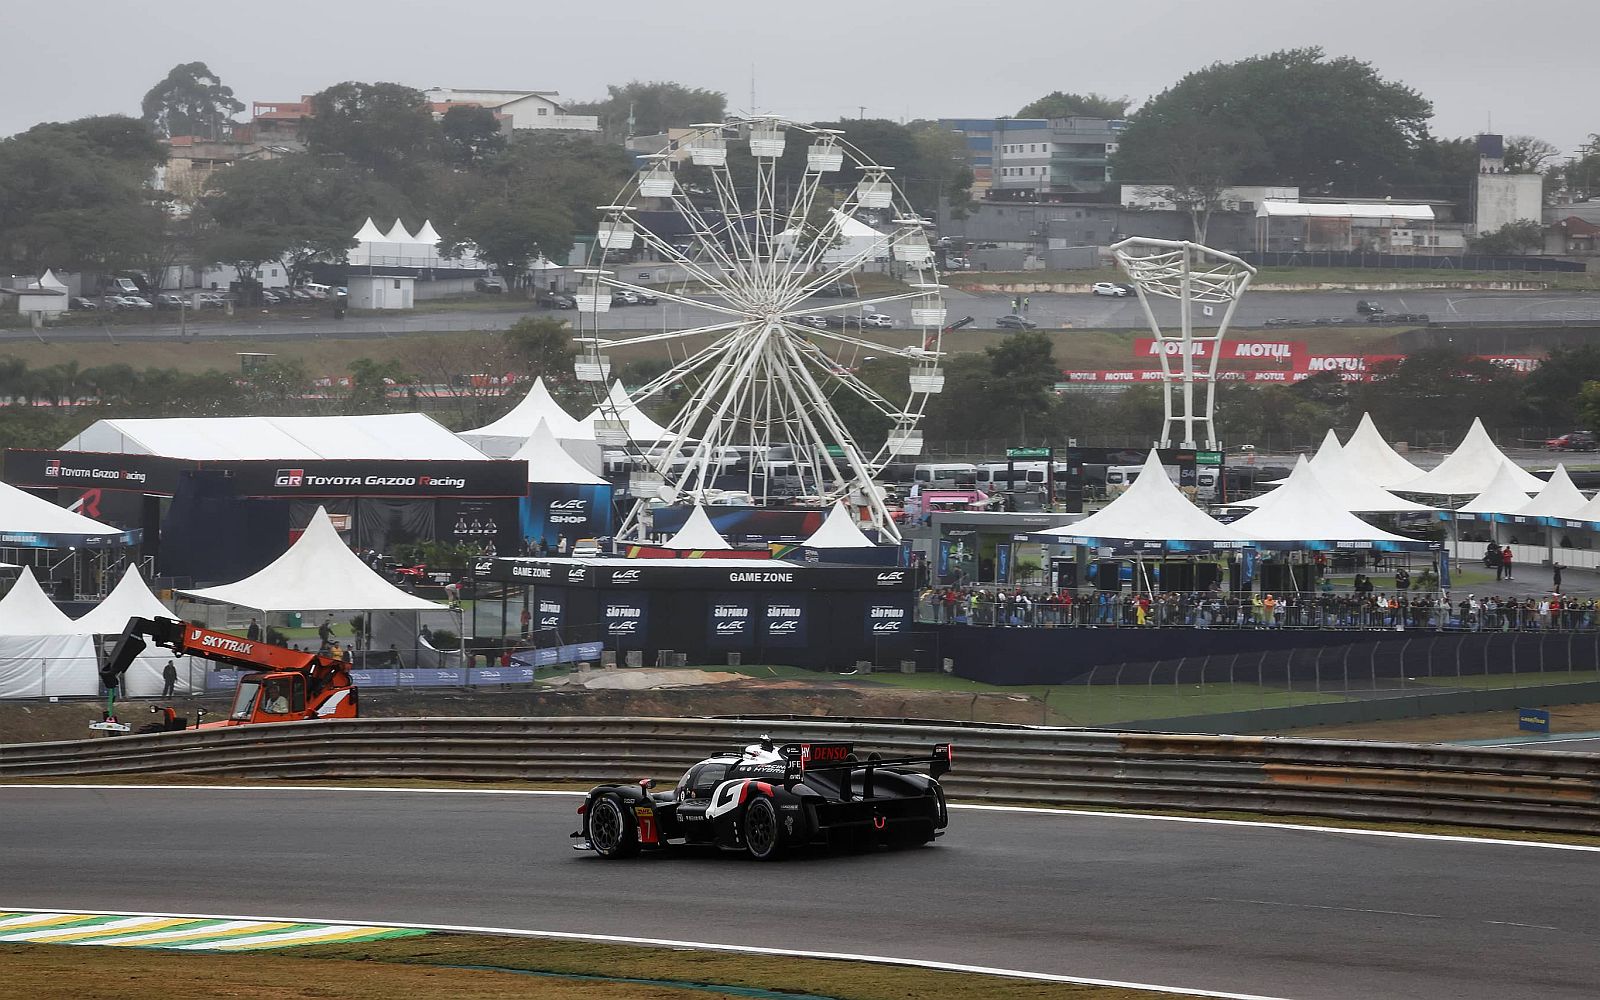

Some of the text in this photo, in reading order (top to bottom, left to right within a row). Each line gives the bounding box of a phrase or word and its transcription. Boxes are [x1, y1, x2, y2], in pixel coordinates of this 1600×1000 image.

[1235, 343, 1292, 357] MOTUL
[1308, 357, 1366, 371] MOTUL
[1104, 372, 1135, 380] MOTUL
[1254, 372, 1286, 381] MOTUL
[61, 467, 91, 478] TOYOTA
[92, 468, 119, 479] GAZOO
[121, 470, 146, 483] Racing
[1181, 469, 1196, 478] 54
[276, 475, 466, 488] GR TOYOTA GAZOO Racing
[550, 500, 587, 509] WEC
[549, 515, 587, 524] SHOP
[512, 566, 551, 578] GAME ZONE
[568, 569, 586, 578] WEC
[612, 569, 641, 579] WEC
[877, 571, 904, 580] WEC
[729, 572, 793, 583] GAME ZONE
[606, 607, 641, 618] SÃO PAULO
[714, 606, 748, 617] SÃO PAULO
[767, 606, 801, 617] SÃO PAULO
[870, 607, 904, 618] SÃO PAULO
[608, 620, 638, 630] WEC
[716, 620, 746, 630] WEC
[769, 620, 799, 630] WEC
[872, 621, 902, 630] WEC
[201, 634, 254, 655] SKYTRAK
[814, 747, 847, 760] DENSO
[788, 761, 801, 769] JFE
[644, 819, 651, 839] 7
